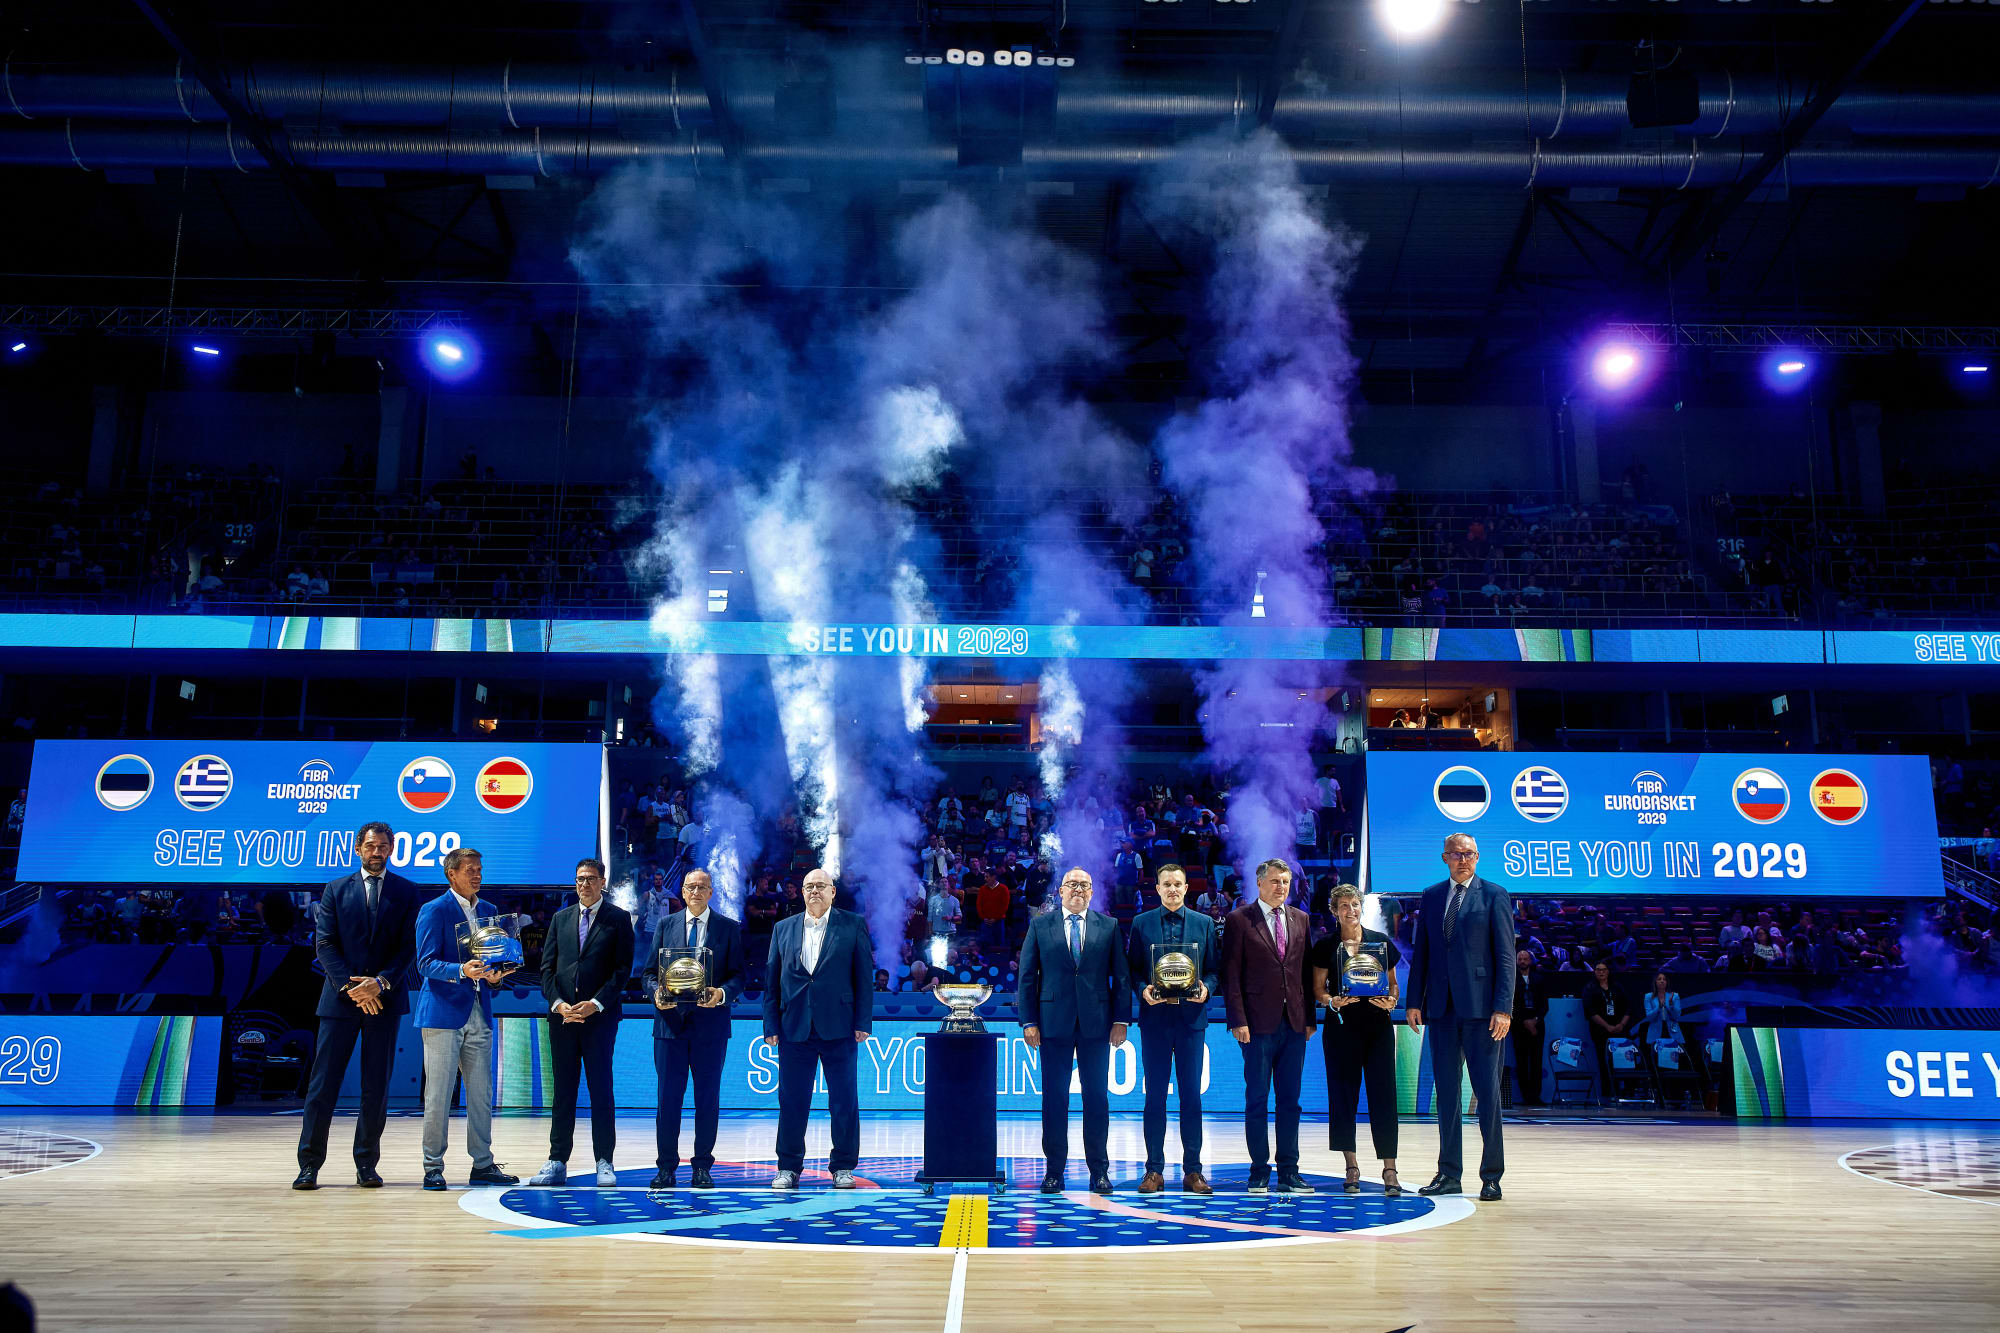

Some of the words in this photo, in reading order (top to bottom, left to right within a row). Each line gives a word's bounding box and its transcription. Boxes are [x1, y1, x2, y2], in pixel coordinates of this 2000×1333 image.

[225, 524, 254, 537] 313
[805, 627, 853, 652] SEE
[862, 627, 913, 653] YOU
[924, 628, 948, 653] IN
[958, 627, 1029, 655] 2029
[1915, 634, 1967, 661] SEE
[303, 769, 329, 782] FIBA
[267, 783, 362, 800] EUROBASKET
[1637, 780, 1662, 793] FIBA
[297, 801, 328, 814] 2029
[1604, 794, 1697, 811] EUROBASKET
[1637, 812, 1667, 825] 2029
[154, 829, 225, 867] SEE
[234, 830, 306, 867] YOU
[316, 831, 354, 867] IN
[391, 831, 461, 867] 029
[1503, 840, 1572, 877] SEE
[1579, 840, 1652, 878] YOU
[1664, 841, 1700, 878] IN
[1711, 842, 1807, 879] 2029
[1885, 1050, 1974, 1098] SEE
